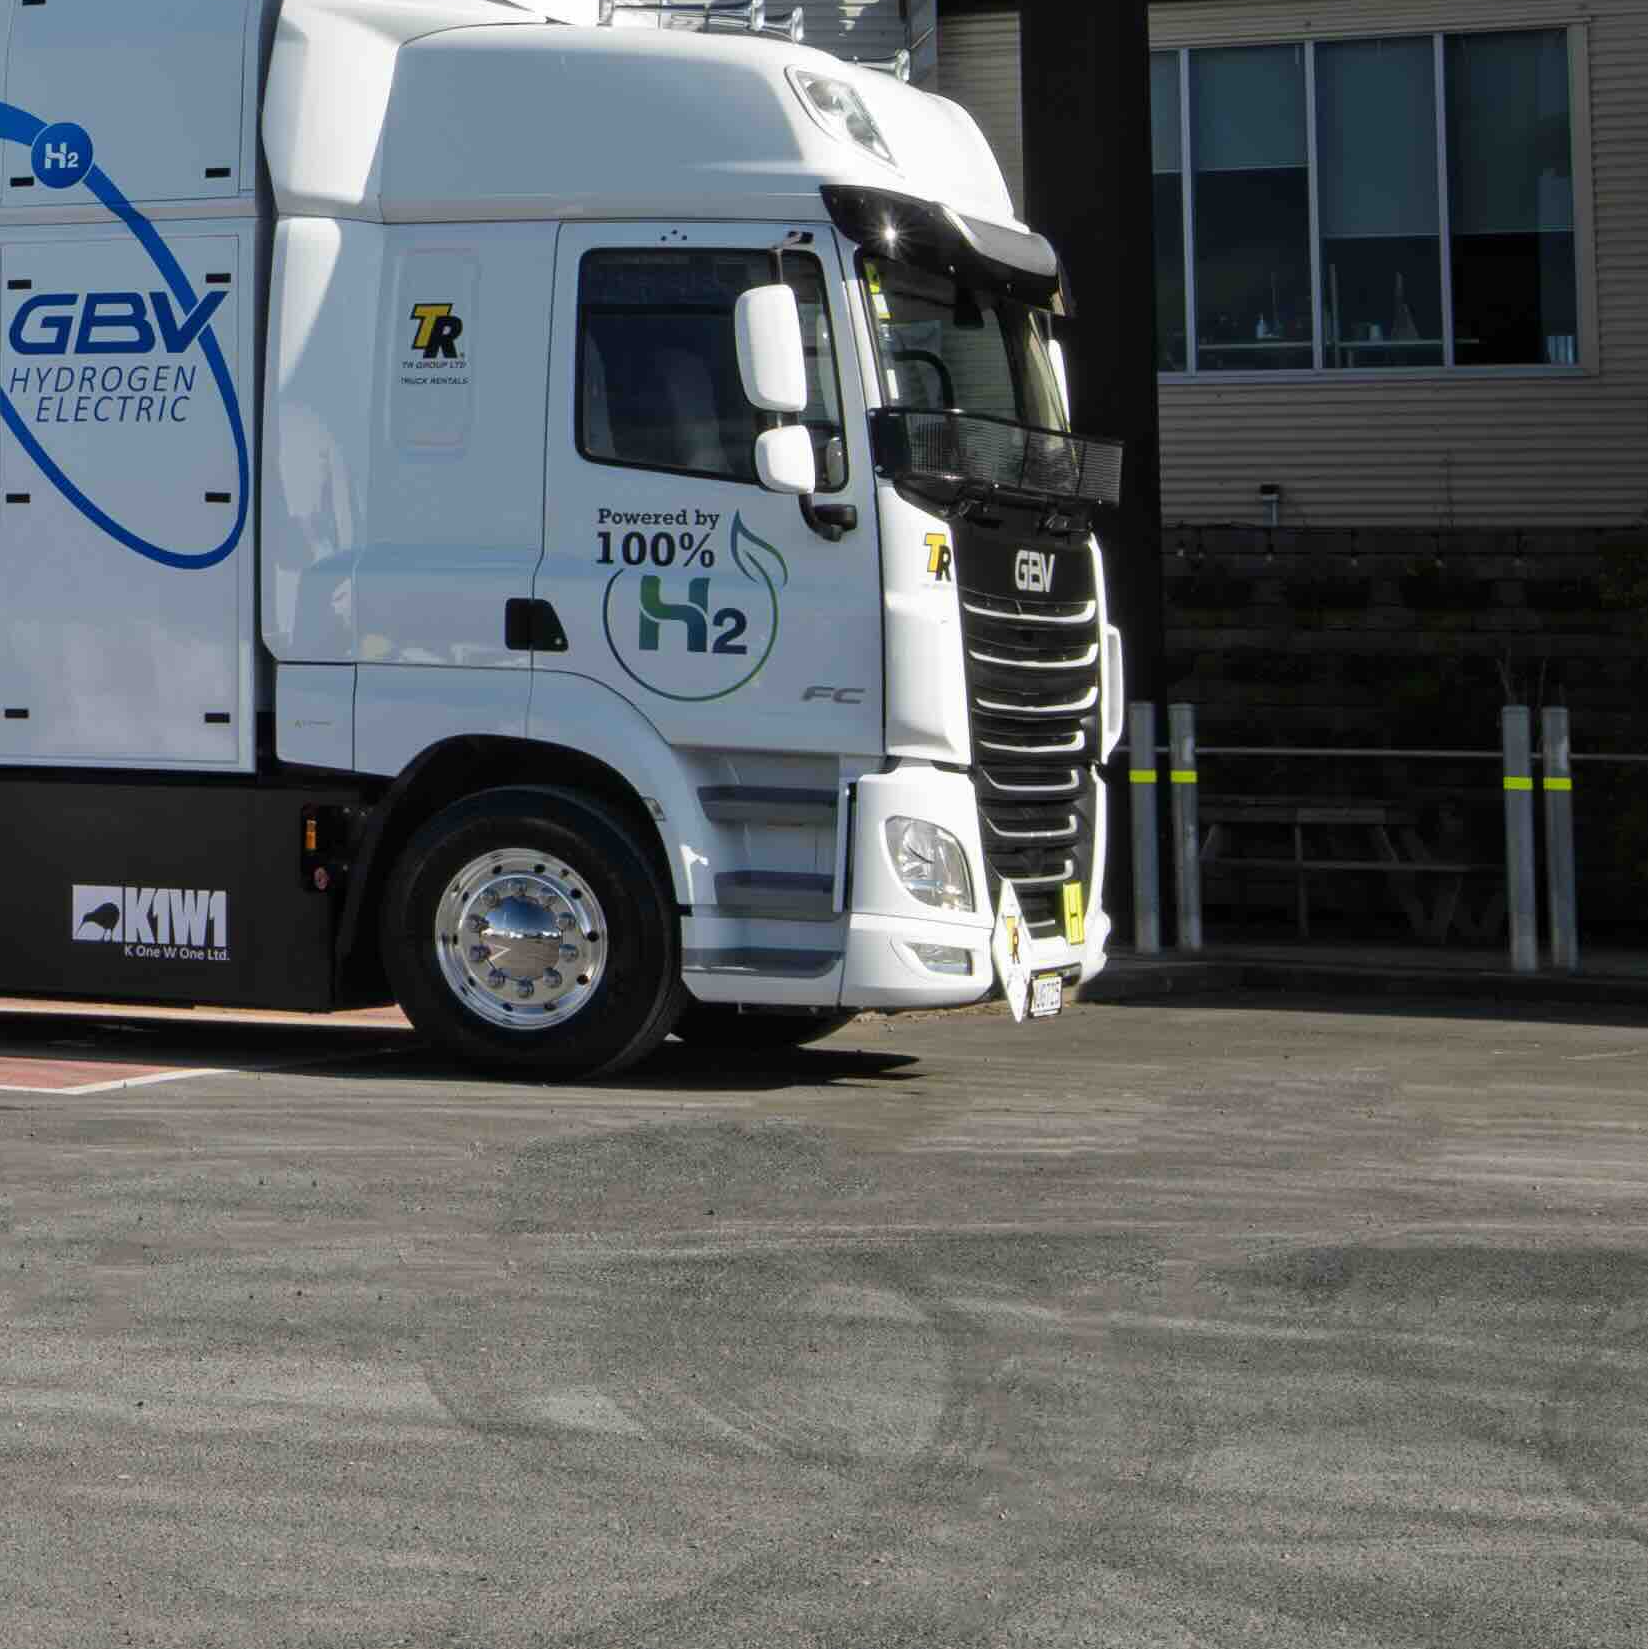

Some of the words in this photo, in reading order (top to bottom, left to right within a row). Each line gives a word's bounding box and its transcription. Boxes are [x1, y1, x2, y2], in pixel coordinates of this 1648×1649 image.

[9, 290, 230, 355] GBV
[409, 303, 463, 359] TR
[9, 364, 197, 393] HYDROGEN
[35, 395, 191, 423] ELECTRIC
[598, 508, 688, 526] Powered
[695, 509, 720, 531] by
[596, 531, 715, 568] 100%
[924, 533, 952, 582] TR
[1014, 550, 1055, 593] GBV
[639, 575, 748, 655] H2
[124, 945, 134, 957] K
[136, 945, 160, 958] One
[162, 946, 177, 958] W
[179, 947, 205, 960] One
[207, 949, 231, 961] Ltd.
